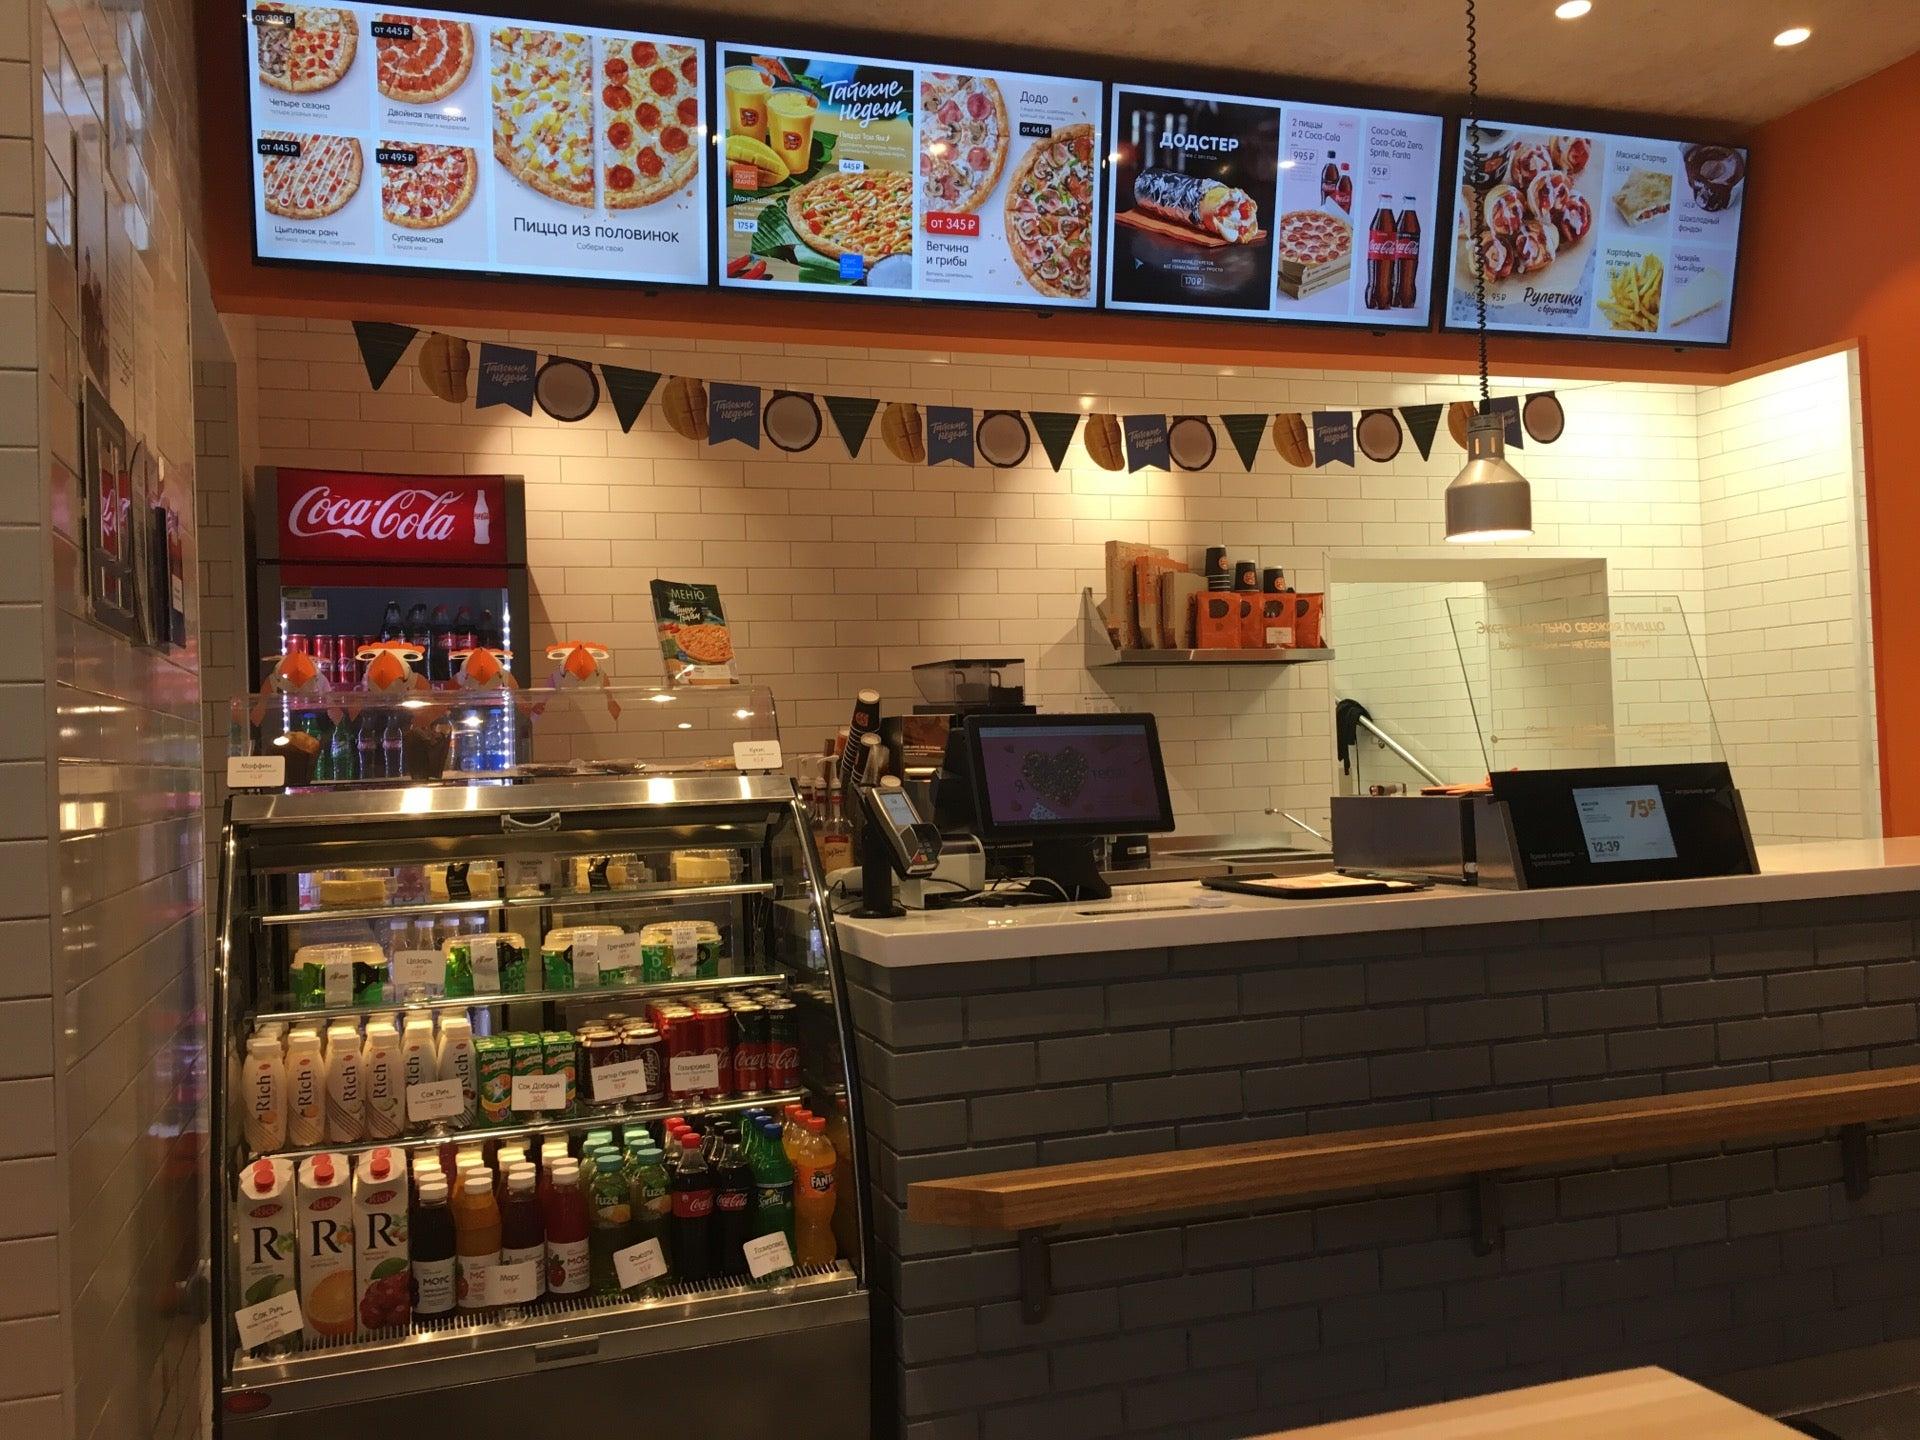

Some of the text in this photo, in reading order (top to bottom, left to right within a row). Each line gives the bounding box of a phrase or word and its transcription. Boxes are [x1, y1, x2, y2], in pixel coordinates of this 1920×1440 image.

[821, 79, 904, 106] Тайские
[1020, 91, 1049, 104] Додо
[268, 98, 331, 111] Четыре сезона
[387, 108, 467, 123] Двойная пепперони
[839, 100, 907, 129] недели
[1292, 118, 1297, 127] 2
[1298, 130, 1303, 139] 2
[261, 143, 270, 151] от
[1159, 132, 1239, 152] ДОДСТЕР
[514, 217, 679, 243] Пицца из половинок
[930, 218, 976, 230] от 345₽
[391, 233, 444, 245] Супермясная
[926, 241, 969, 254] Ветчина
[935, 256, 967, 268] грибы
[1523, 287, 1583, 307] Рулетики
[288, 485, 465, 542] Coca-Cola
[670, 588, 705, 601] МЕНЮ
[1592, 840, 1620, 853] 12:39
[297, 1069, 312, 1106] Rich
[343, 1065, 355, 1101] Rich
[373, 1063, 387, 1099] Rich
[532, 1082, 560, 1090] Добрый
[256, 1073, 272, 1111] Rich
[642, 1185, 666, 1197] fuze
[595, 1193, 619, 1206] fuze
[367, 1212, 397, 1249] R
[311, 1219, 343, 1256] R
[252, 1226, 284, 1264] R
[501, 1274, 520, 1283] Морс
